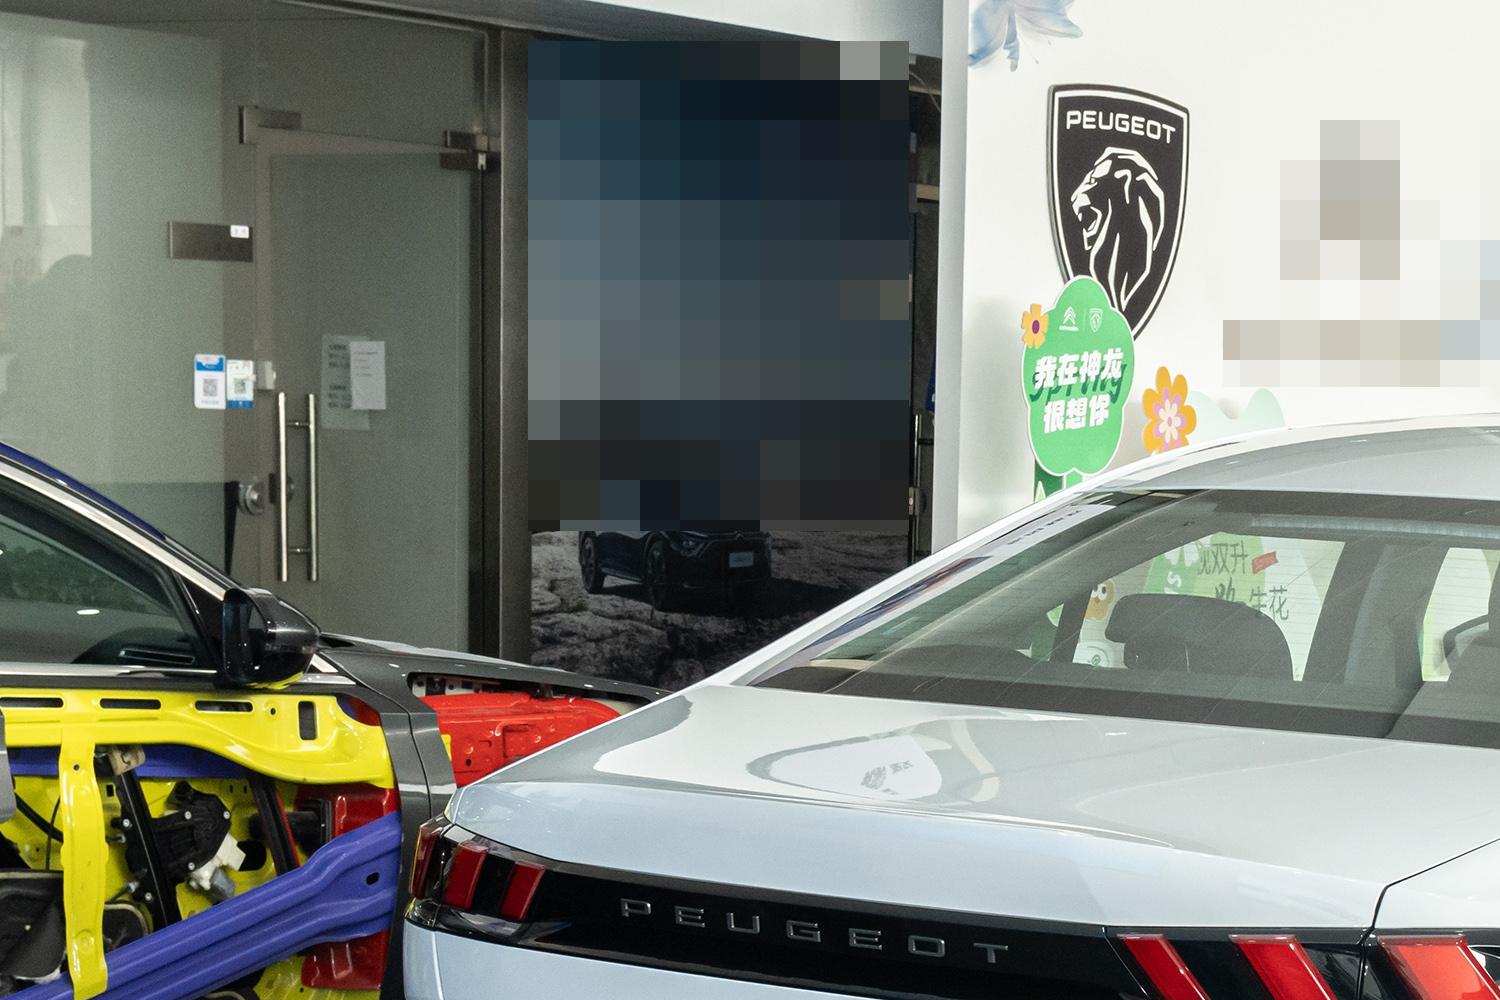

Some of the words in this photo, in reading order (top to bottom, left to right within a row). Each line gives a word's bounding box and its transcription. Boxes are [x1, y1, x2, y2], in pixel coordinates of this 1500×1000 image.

[1066, 110, 1176, 144] PEUGEOT
[1034, 347, 1124, 389] 我在神龙
[1043, 394, 1110, 434] 很想你
[621, 899, 1009, 964] PEUGEOT
